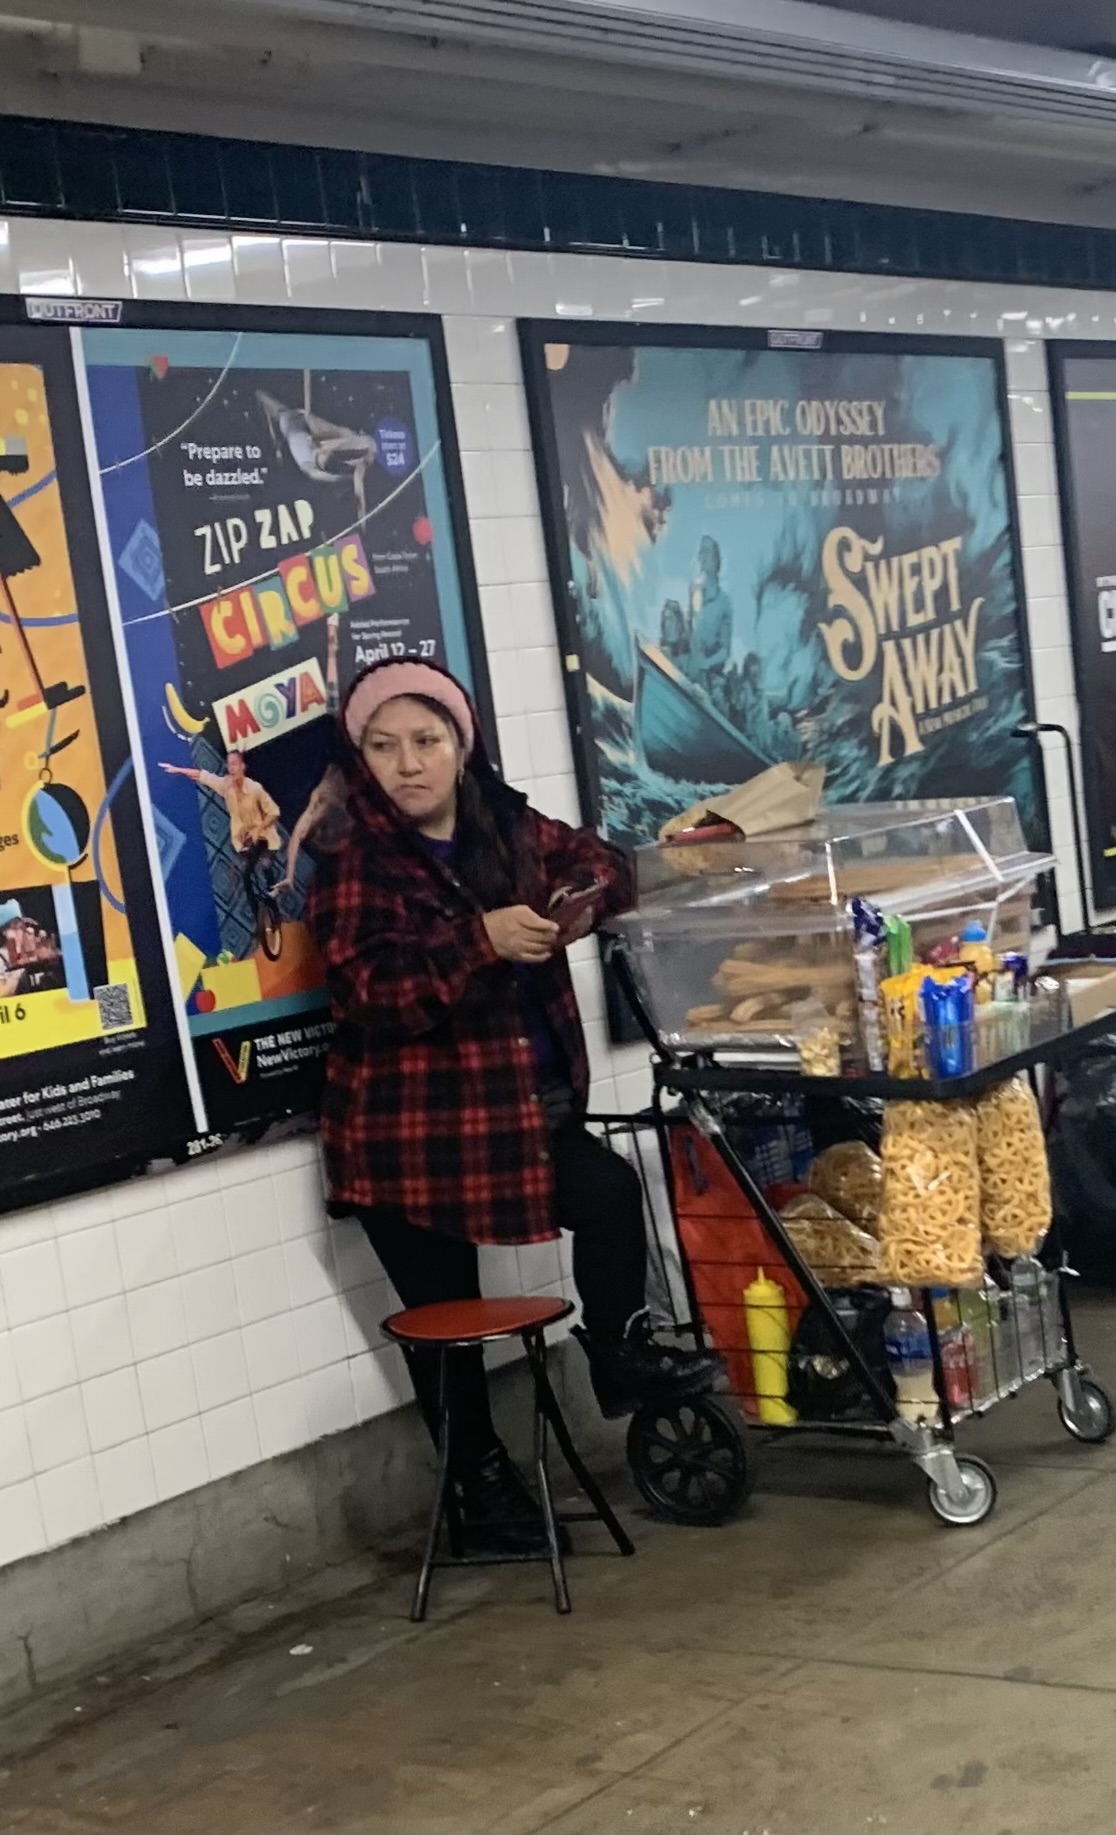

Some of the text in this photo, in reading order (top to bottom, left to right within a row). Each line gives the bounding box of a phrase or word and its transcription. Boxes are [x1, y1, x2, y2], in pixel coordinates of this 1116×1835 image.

[30, 302, 116, 319] OUTFRONT
[708, 399, 886, 437] AN EPIC ODYSSEY
[245, 445, 262, 459] to
[648, 443, 941, 485] FROM THE AVETT BROTHERS
[183, 469, 204, 487] be
[194, 499, 315, 576] ZIP ZAP
[208, 542, 371, 656] CIRCUS
[816, 525, 963, 681] SWEPT
[355, 644, 390, 665] April
[419, 639, 437, 657] 27
[871, 596, 986, 768] AWAY
[224, 670, 327, 744] MOYA
[15, 1001, 26, 1021] 6
[253, 1034, 277, 1051] THE
[276, 1029, 302, 1046] NEW
[256, 1042, 331, 1068] NewVictory.o
[23, 1091, 41, 1104] for
[41, 1084, 68, 1099] Kids
[68, 1077, 91, 1094] and
[90, 1069, 135, 1088] Families
